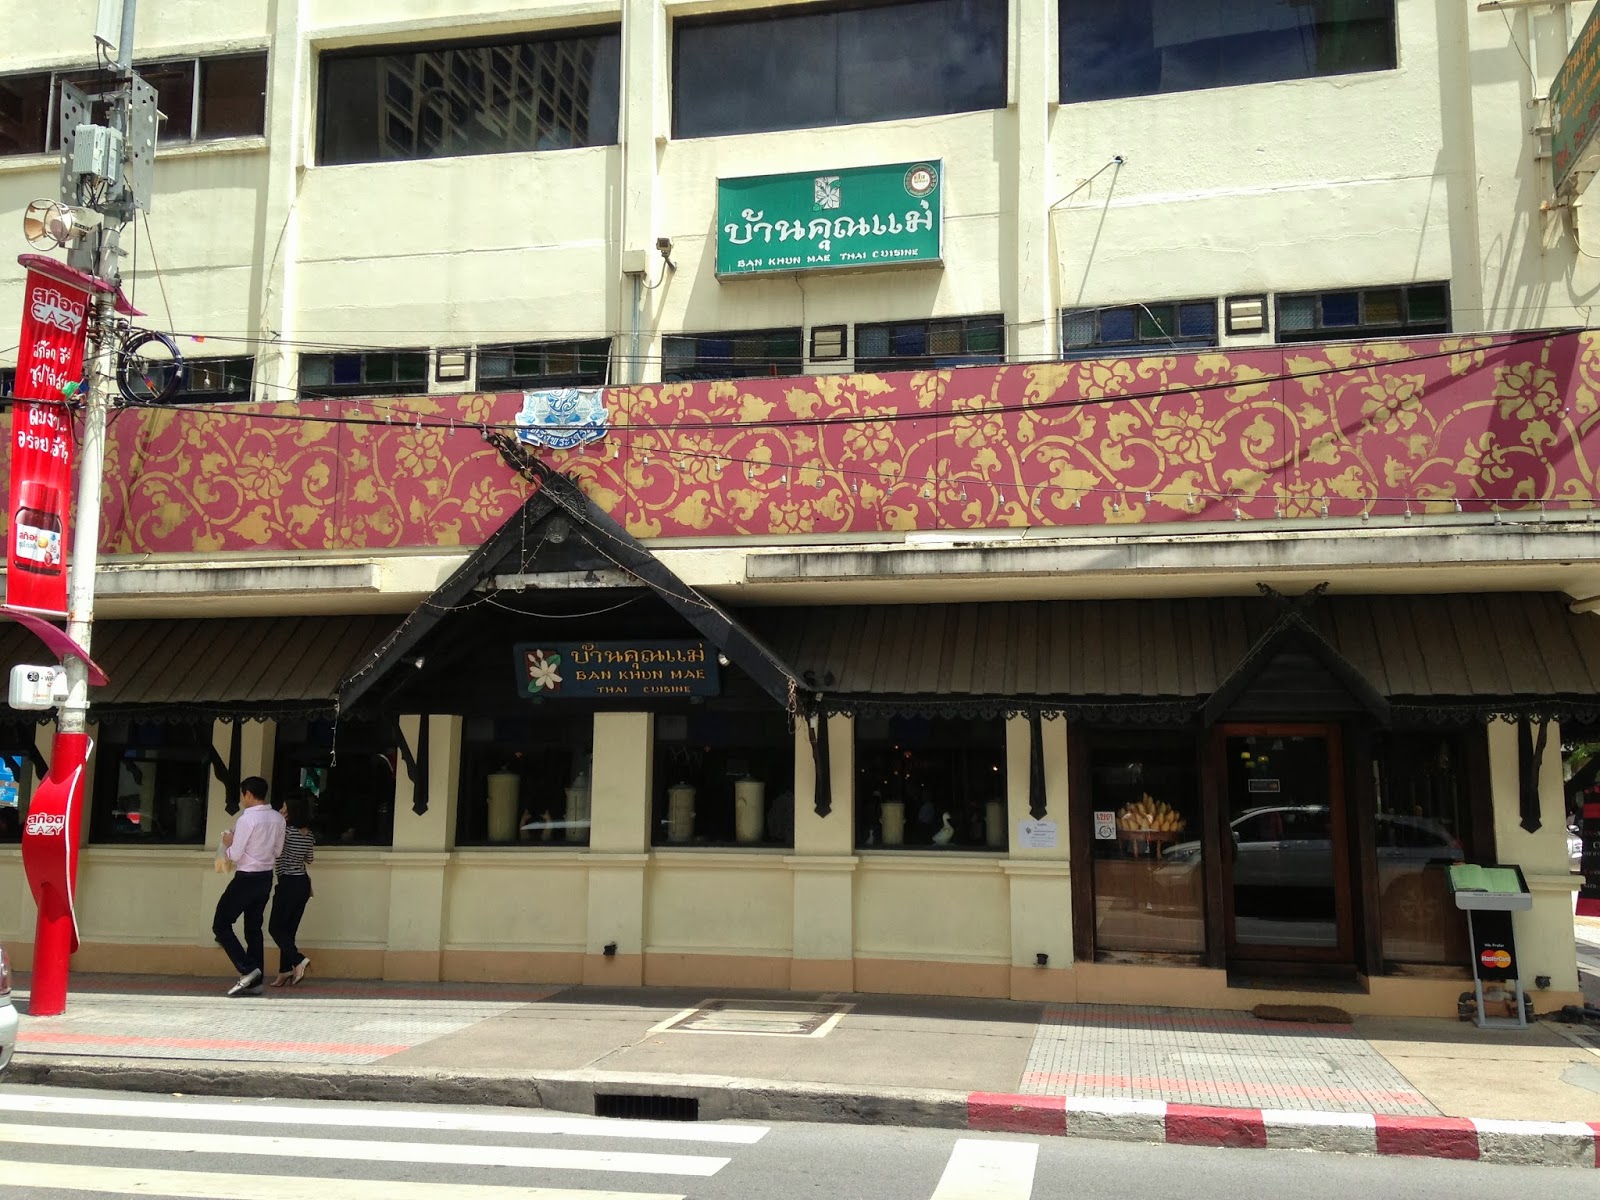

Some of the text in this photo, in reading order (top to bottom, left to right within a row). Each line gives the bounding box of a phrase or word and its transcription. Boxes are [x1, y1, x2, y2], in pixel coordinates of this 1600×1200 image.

[724, 199, 933, 251] บ้านคุณแม่
[768, 256, 801, 266] KHUN
[806, 254, 831, 263] MAE
[839, 252, 867, 261] THAI
[872, 248, 919, 259] CUISINE
[32, 302, 82, 334] EAZY
[570, 643, 705, 670] บ้านคุณแม่
[576, 669, 705, 680] BAN KHUN MAE
[26, 823, 64, 835] EAZY
